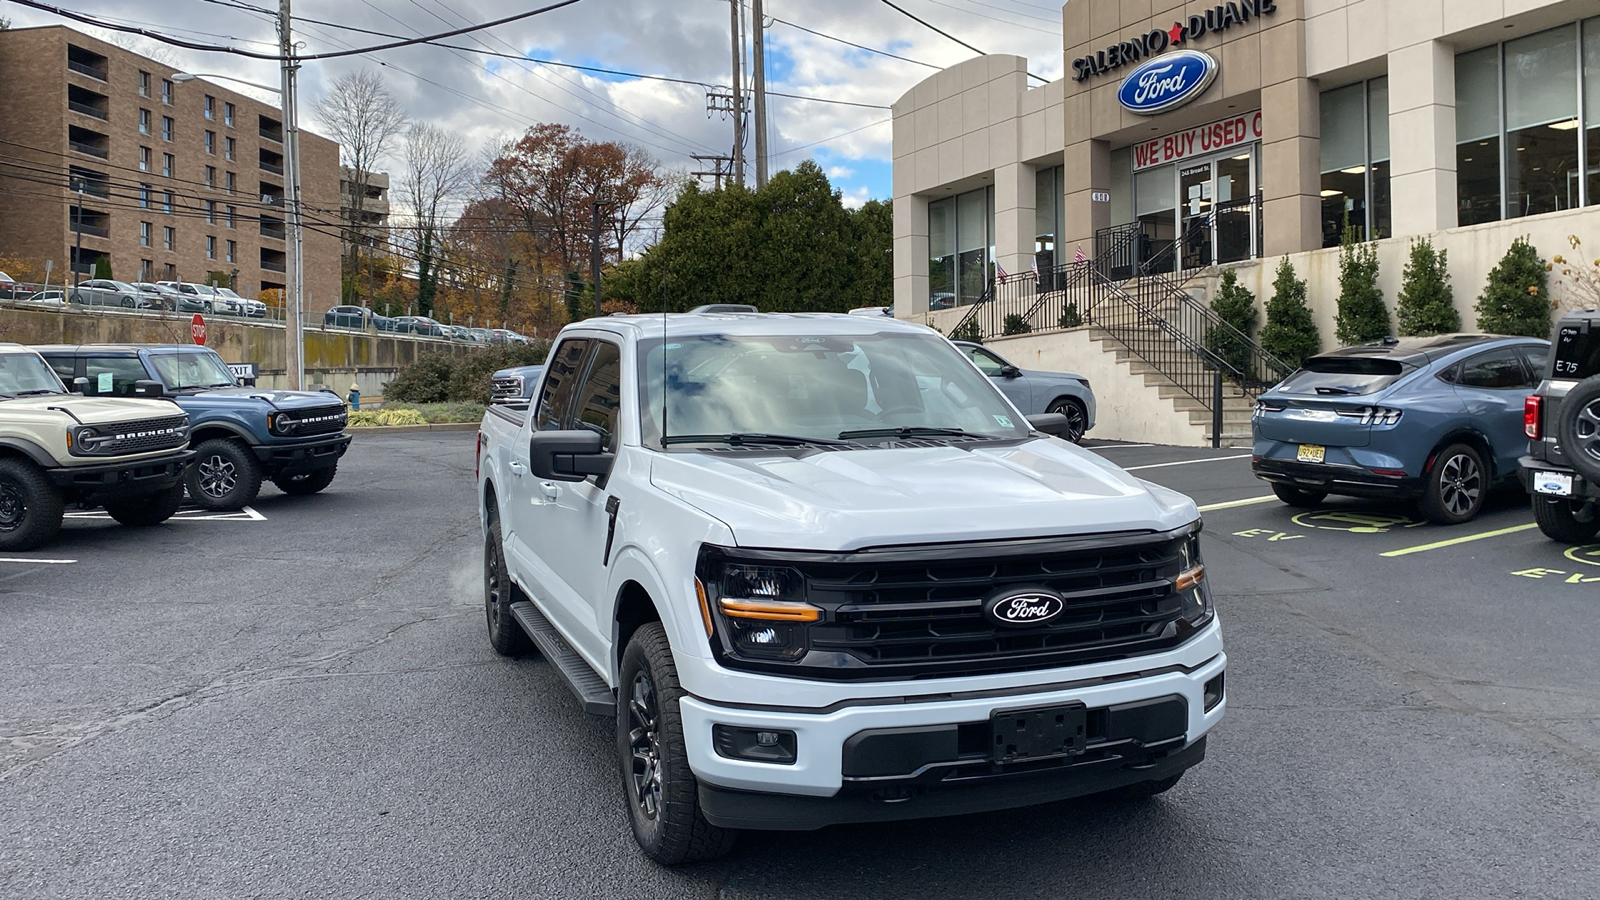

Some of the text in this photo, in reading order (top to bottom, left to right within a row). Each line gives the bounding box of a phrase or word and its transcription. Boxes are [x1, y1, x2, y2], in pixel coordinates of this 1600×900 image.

[1072, 28, 1169, 82] SALERNO
[1134, 64, 1187, 103] Ford
[1135, 140, 1159, 168] WE
[1163, 130, 1197, 161] BUY
[1201, 117, 1247, 151] USED
[192, 324, 206, 338] STOP
[302, 414, 340, 424] BRONCO
[116, 428, 174, 440] BRONCO
[1007, 597, 1050, 619] Ford
